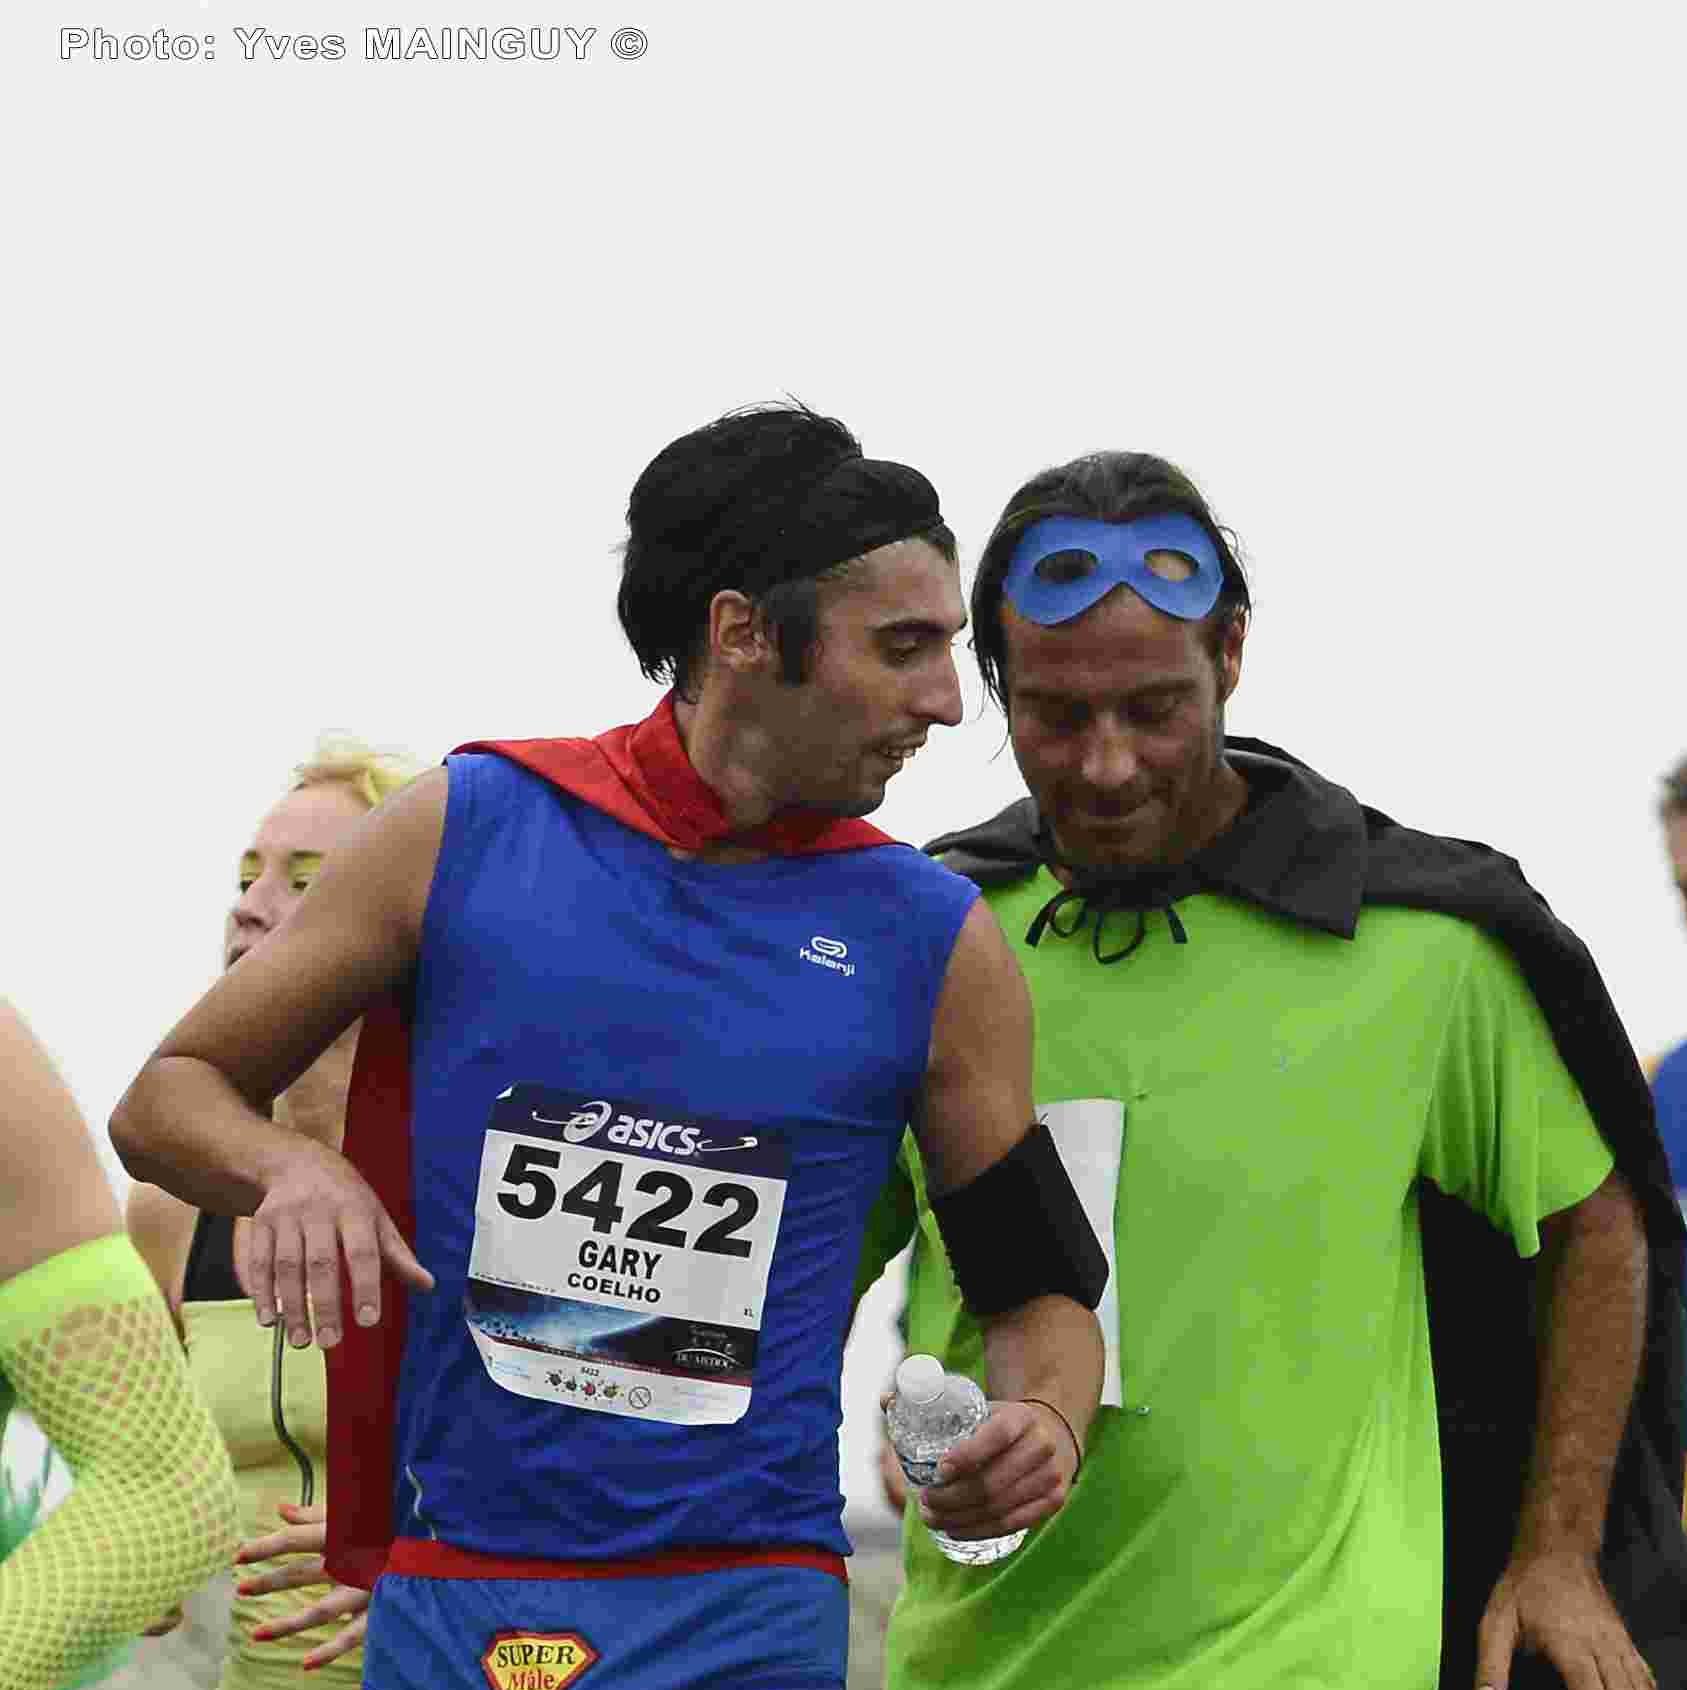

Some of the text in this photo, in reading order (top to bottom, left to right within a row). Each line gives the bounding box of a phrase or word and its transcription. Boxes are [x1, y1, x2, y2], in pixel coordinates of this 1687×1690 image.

[496, 1144, 760, 1258] 5422
[578, 1240, 663, 1279] GARY
[567, 1273, 661, 1303] COELHO
[496, 1644, 576, 1668] SUPER
